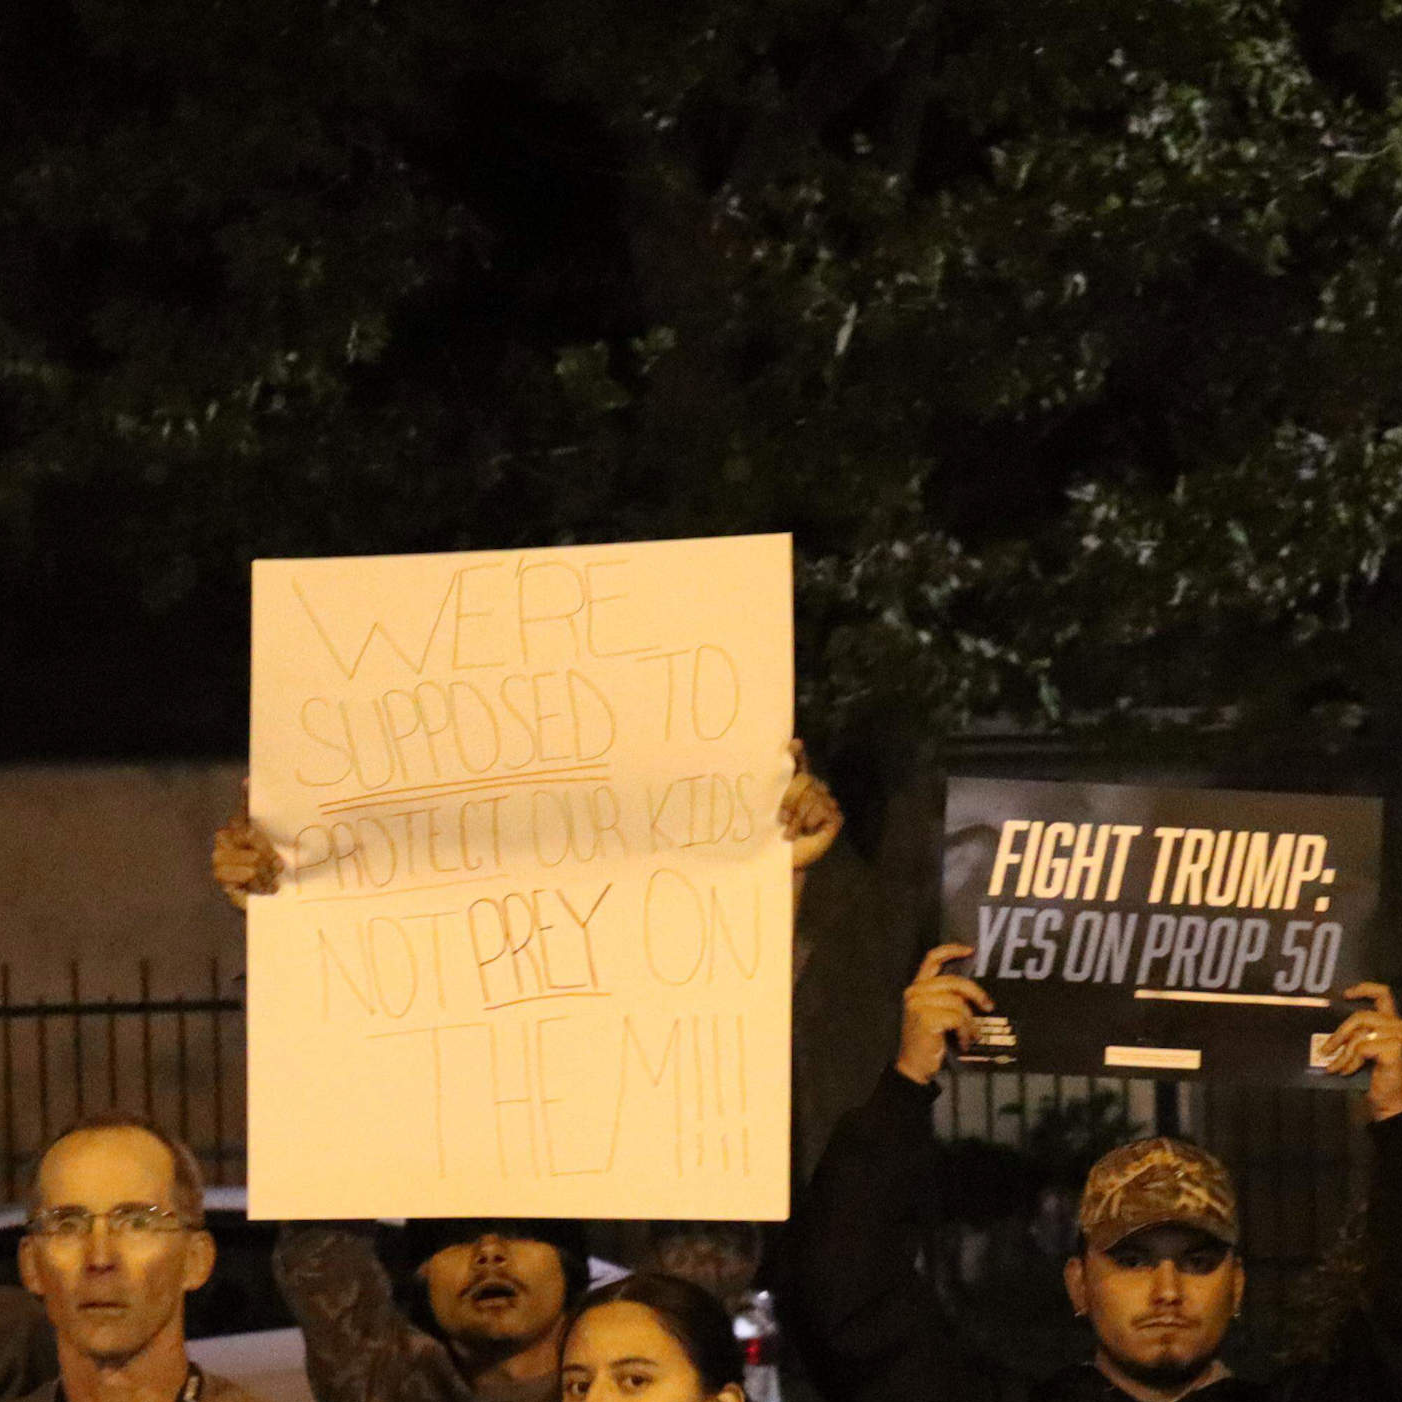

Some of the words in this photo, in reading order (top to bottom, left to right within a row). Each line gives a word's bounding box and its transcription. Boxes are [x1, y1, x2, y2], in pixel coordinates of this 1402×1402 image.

[296, 668, 616, 791] SUPPOSED
[636, 643, 740, 743] TO
[295, 795, 511, 894] PROTECT
[532, 785, 628, 869] OUR
[647, 772, 756, 849] KIDS
[987, 819, 1143, 902] FIGHT
[1148, 827, 1336, 912] TRUMP:
[318, 911, 463, 1022] NOT
[468, 882, 613, 1003] PREY
[643, 869, 762, 986] ON
[974, 906, 1062, 980] YES
[1062, 911, 1138, 984] ON
[1135, 914, 1270, 990] PROP
[1273, 920, 1344, 993] 50
